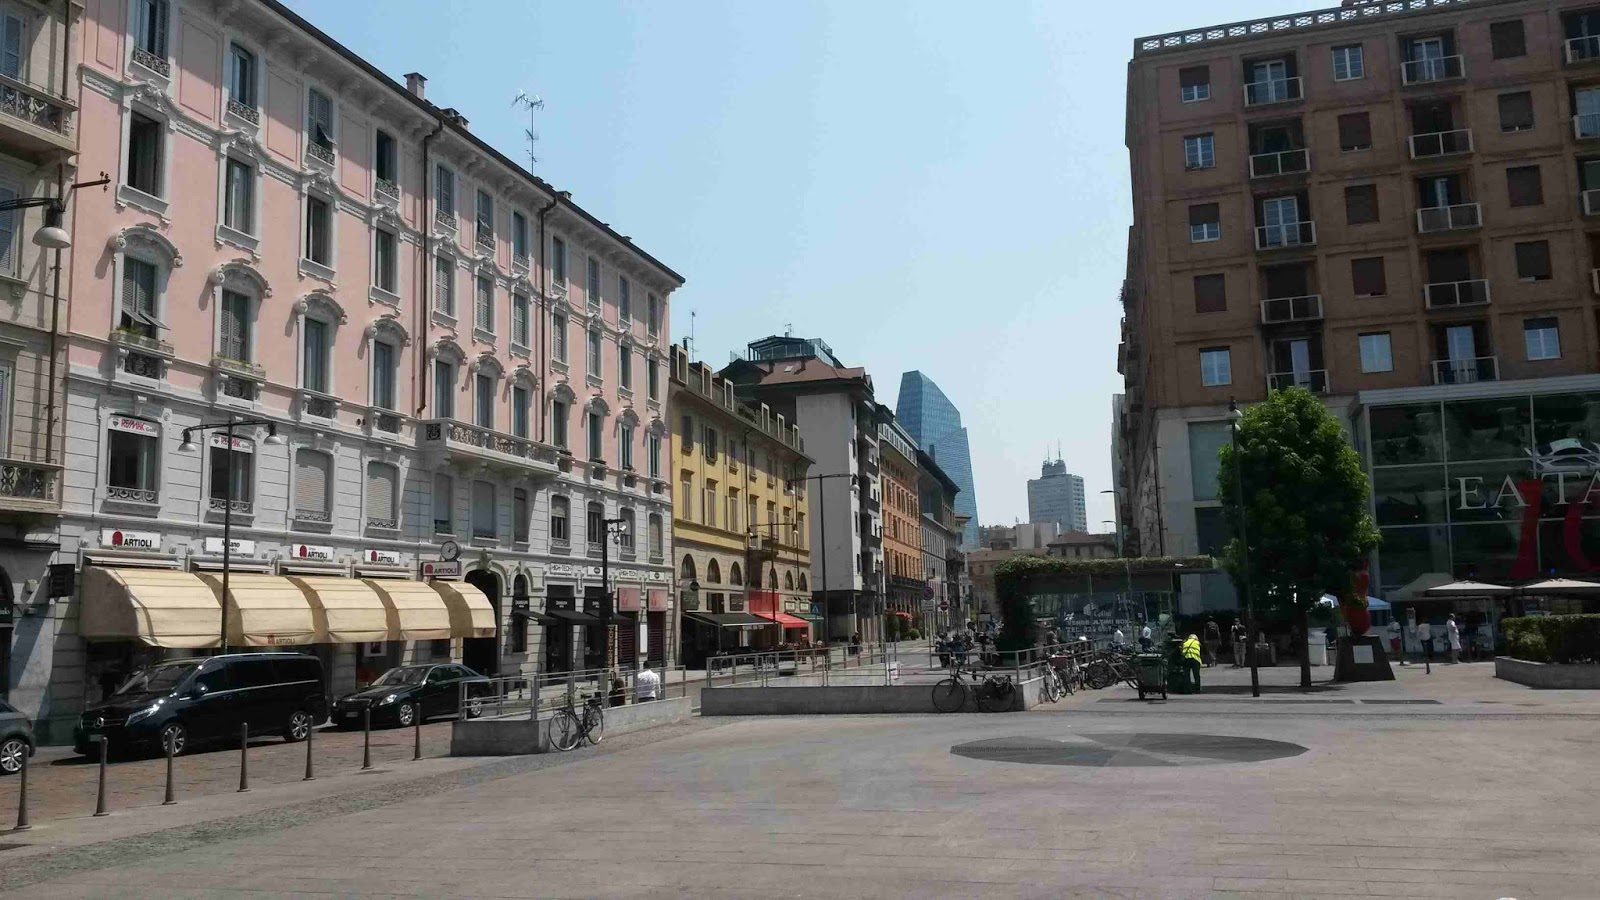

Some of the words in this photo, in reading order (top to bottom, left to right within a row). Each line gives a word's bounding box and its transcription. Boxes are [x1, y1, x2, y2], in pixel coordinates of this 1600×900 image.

[123, 538, 152, 548] ARTIOLI
[307, 550, 328, 559] ARTIOLI
[377, 555, 395, 563] ARTIOLI
